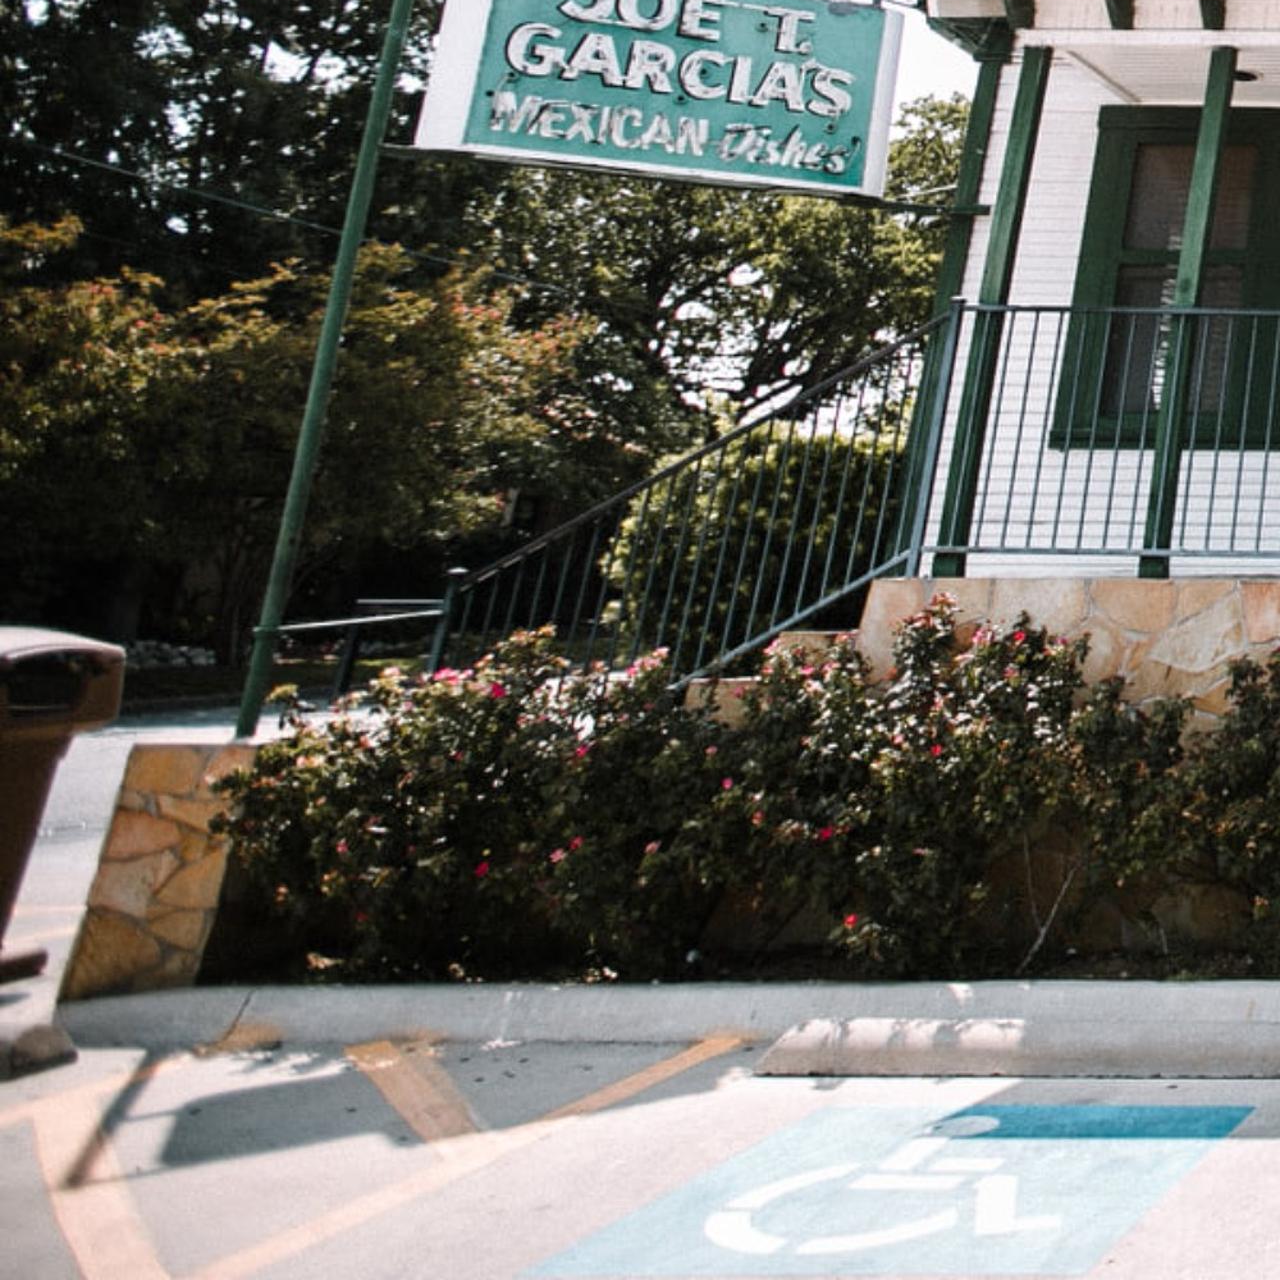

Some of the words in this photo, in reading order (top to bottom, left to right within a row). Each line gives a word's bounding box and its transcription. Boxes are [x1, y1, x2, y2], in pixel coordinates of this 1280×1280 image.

[505, 22, 855, 116] GARCIA'S
[764, 6, 815, 55] T.
[489, 90, 710, 156] MEXICAN
[718, 122, 848, 173] Dishes
